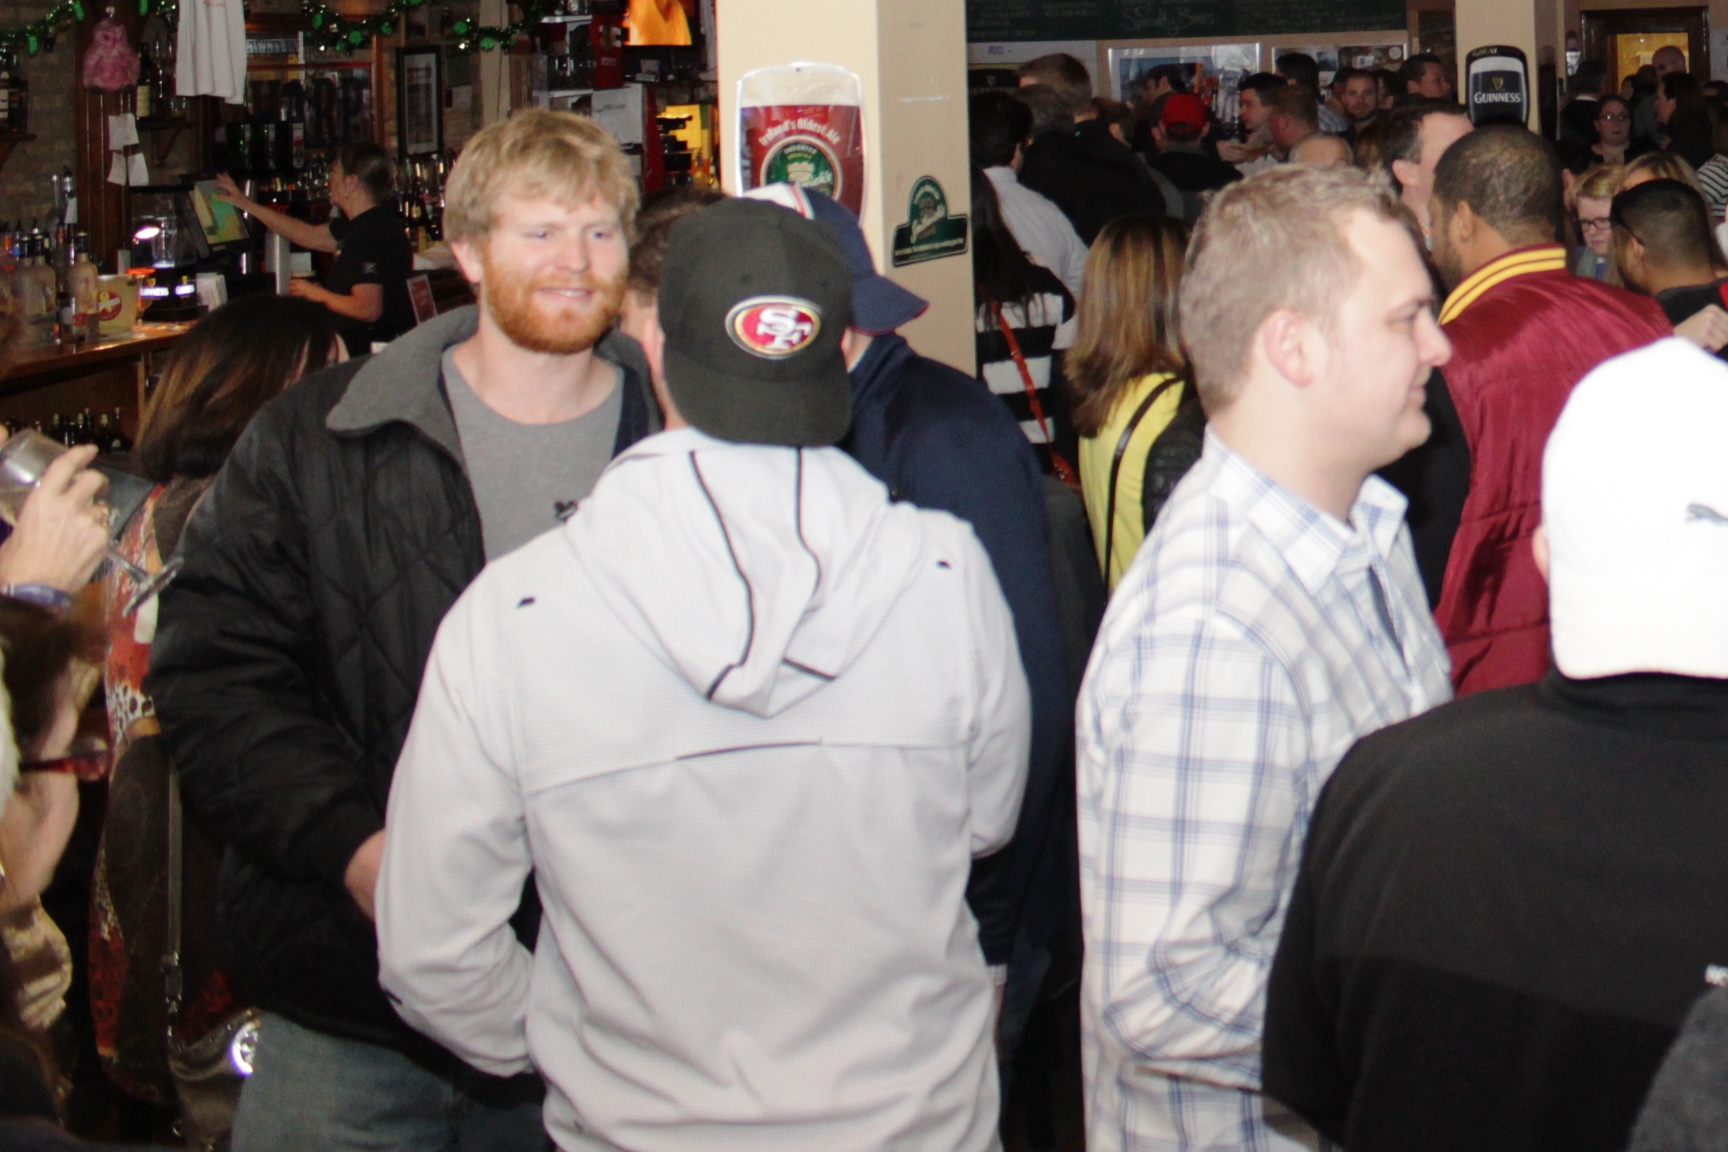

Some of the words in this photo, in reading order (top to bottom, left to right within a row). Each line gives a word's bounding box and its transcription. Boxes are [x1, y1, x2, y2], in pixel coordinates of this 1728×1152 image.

[1474, 92, 1521, 104] GUINNESS
[758, 118, 796, 147] Ireland's
[797, 117, 826, 135] Oldest
[826, 129, 841, 145] Ale
